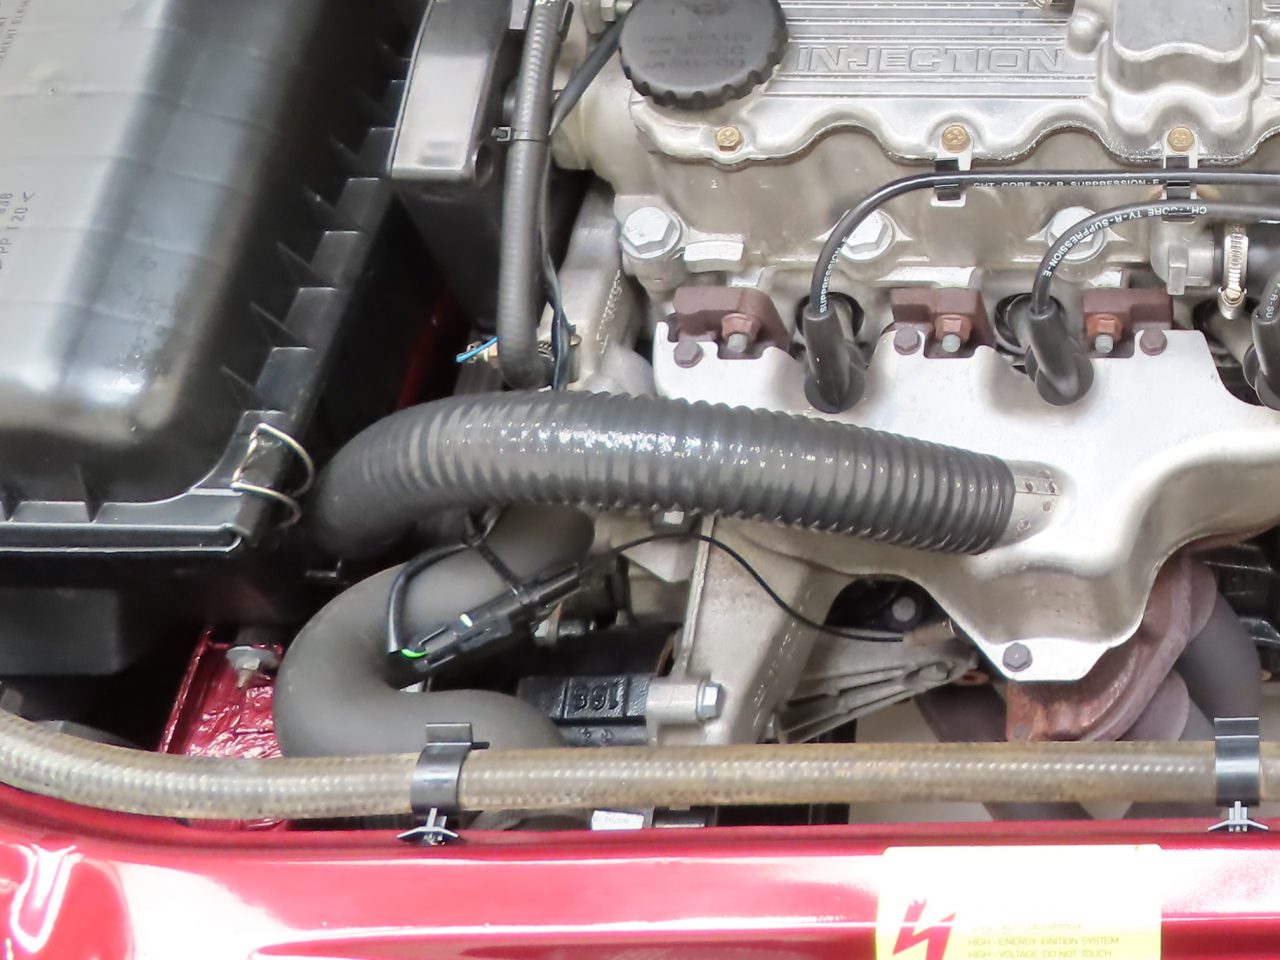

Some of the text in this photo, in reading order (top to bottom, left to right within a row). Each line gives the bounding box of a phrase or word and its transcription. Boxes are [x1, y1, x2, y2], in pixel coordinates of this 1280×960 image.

[797, 44, 1066, 73] INJECTION
[1043, 209, 1143, 278] TV-R-SUPPRESSION-E
[967, 936, 992, 946] HIGH
[997, 935, 1038, 946] ENERGY
[1040, 935, 1079, 946] IGNITION
[1081, 934, 1120, 945] SYSTEM
[967, 949, 992, 959] HIGH
[1080, 947, 1113, 959] TOUCH
